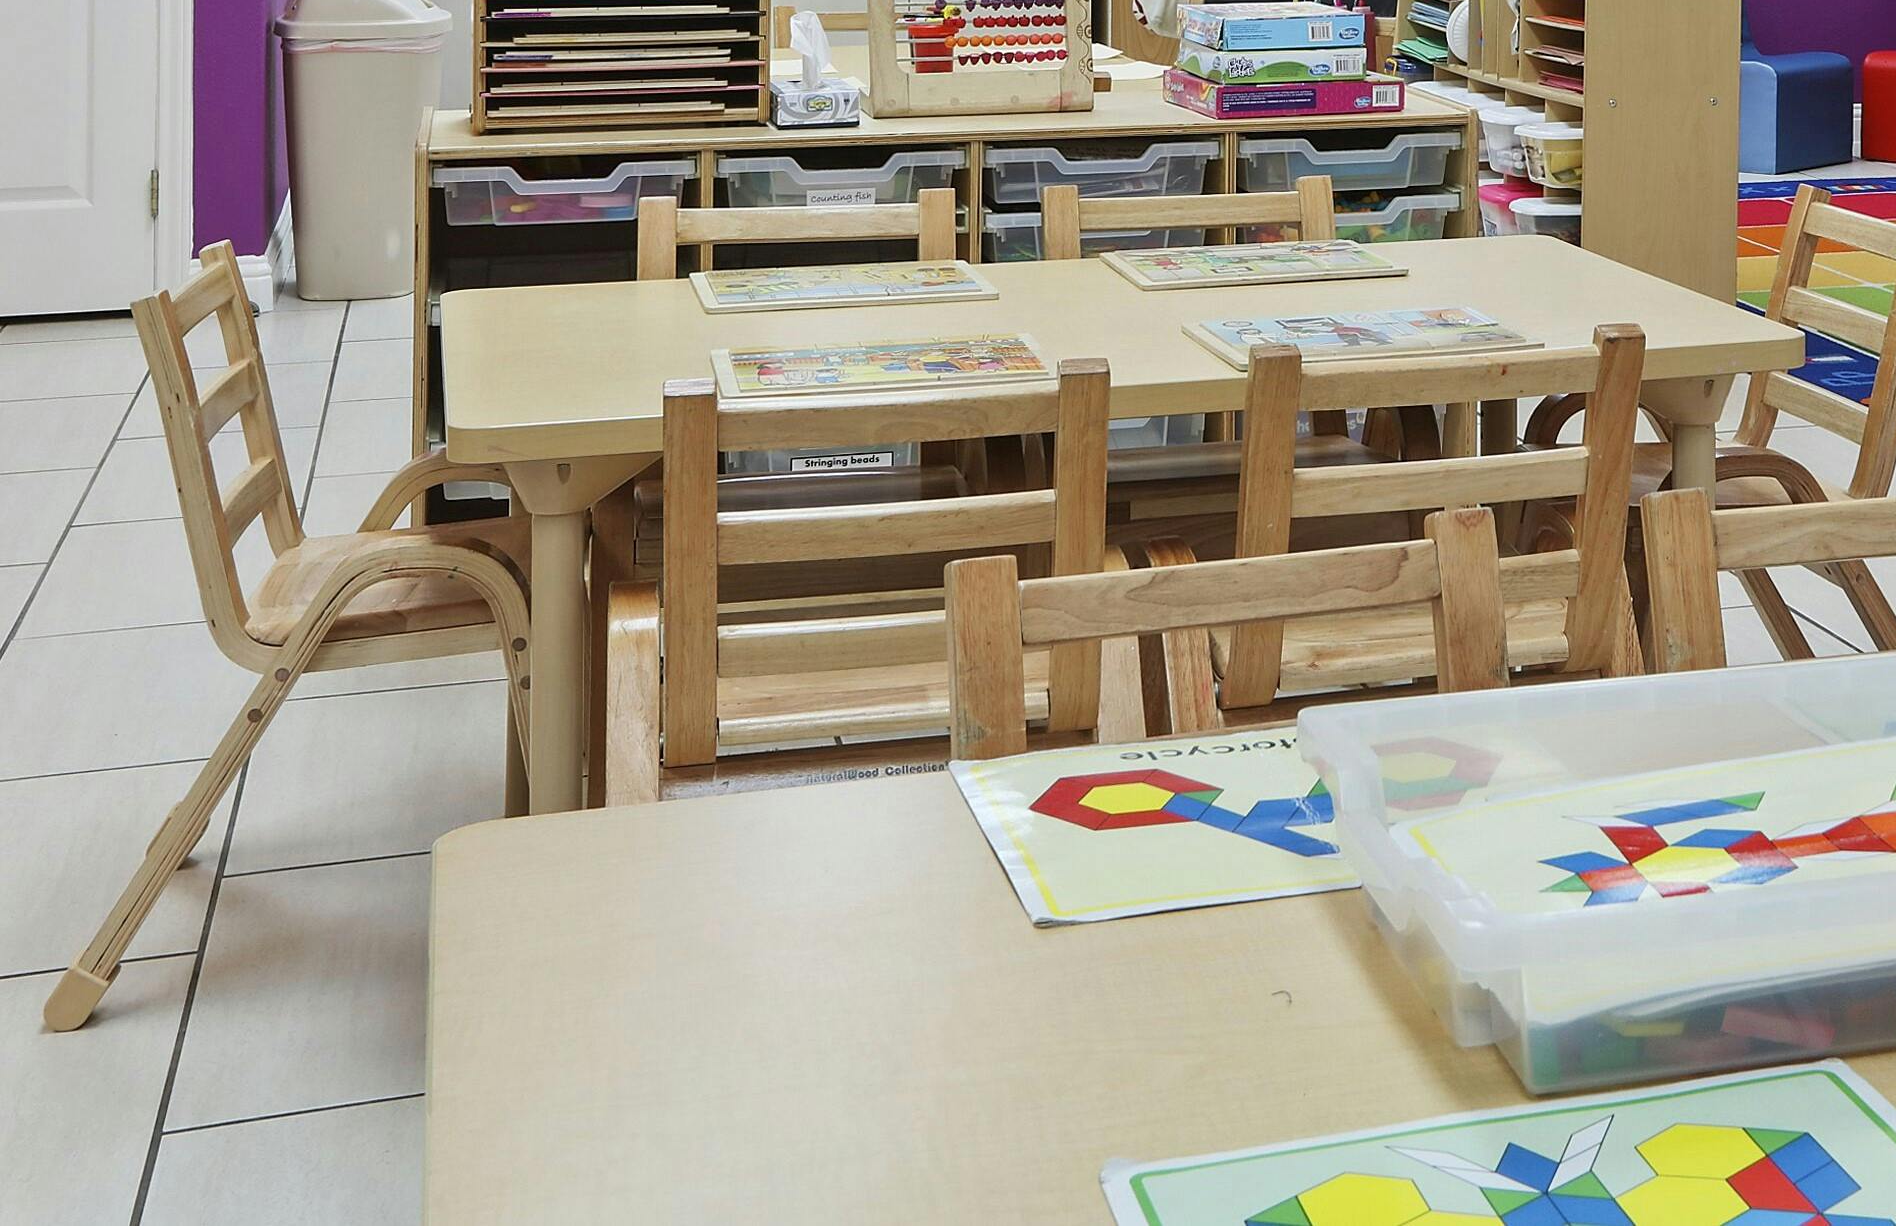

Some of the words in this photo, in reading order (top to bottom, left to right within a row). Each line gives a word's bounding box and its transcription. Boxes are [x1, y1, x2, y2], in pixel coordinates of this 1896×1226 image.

[810, 192, 853, 203] Counting
[854, 191, 872, 202] fish
[804, 457, 848, 468] Stringing
[850, 454, 880, 465] beads
[1120, 738, 1294, 762] torcycle
